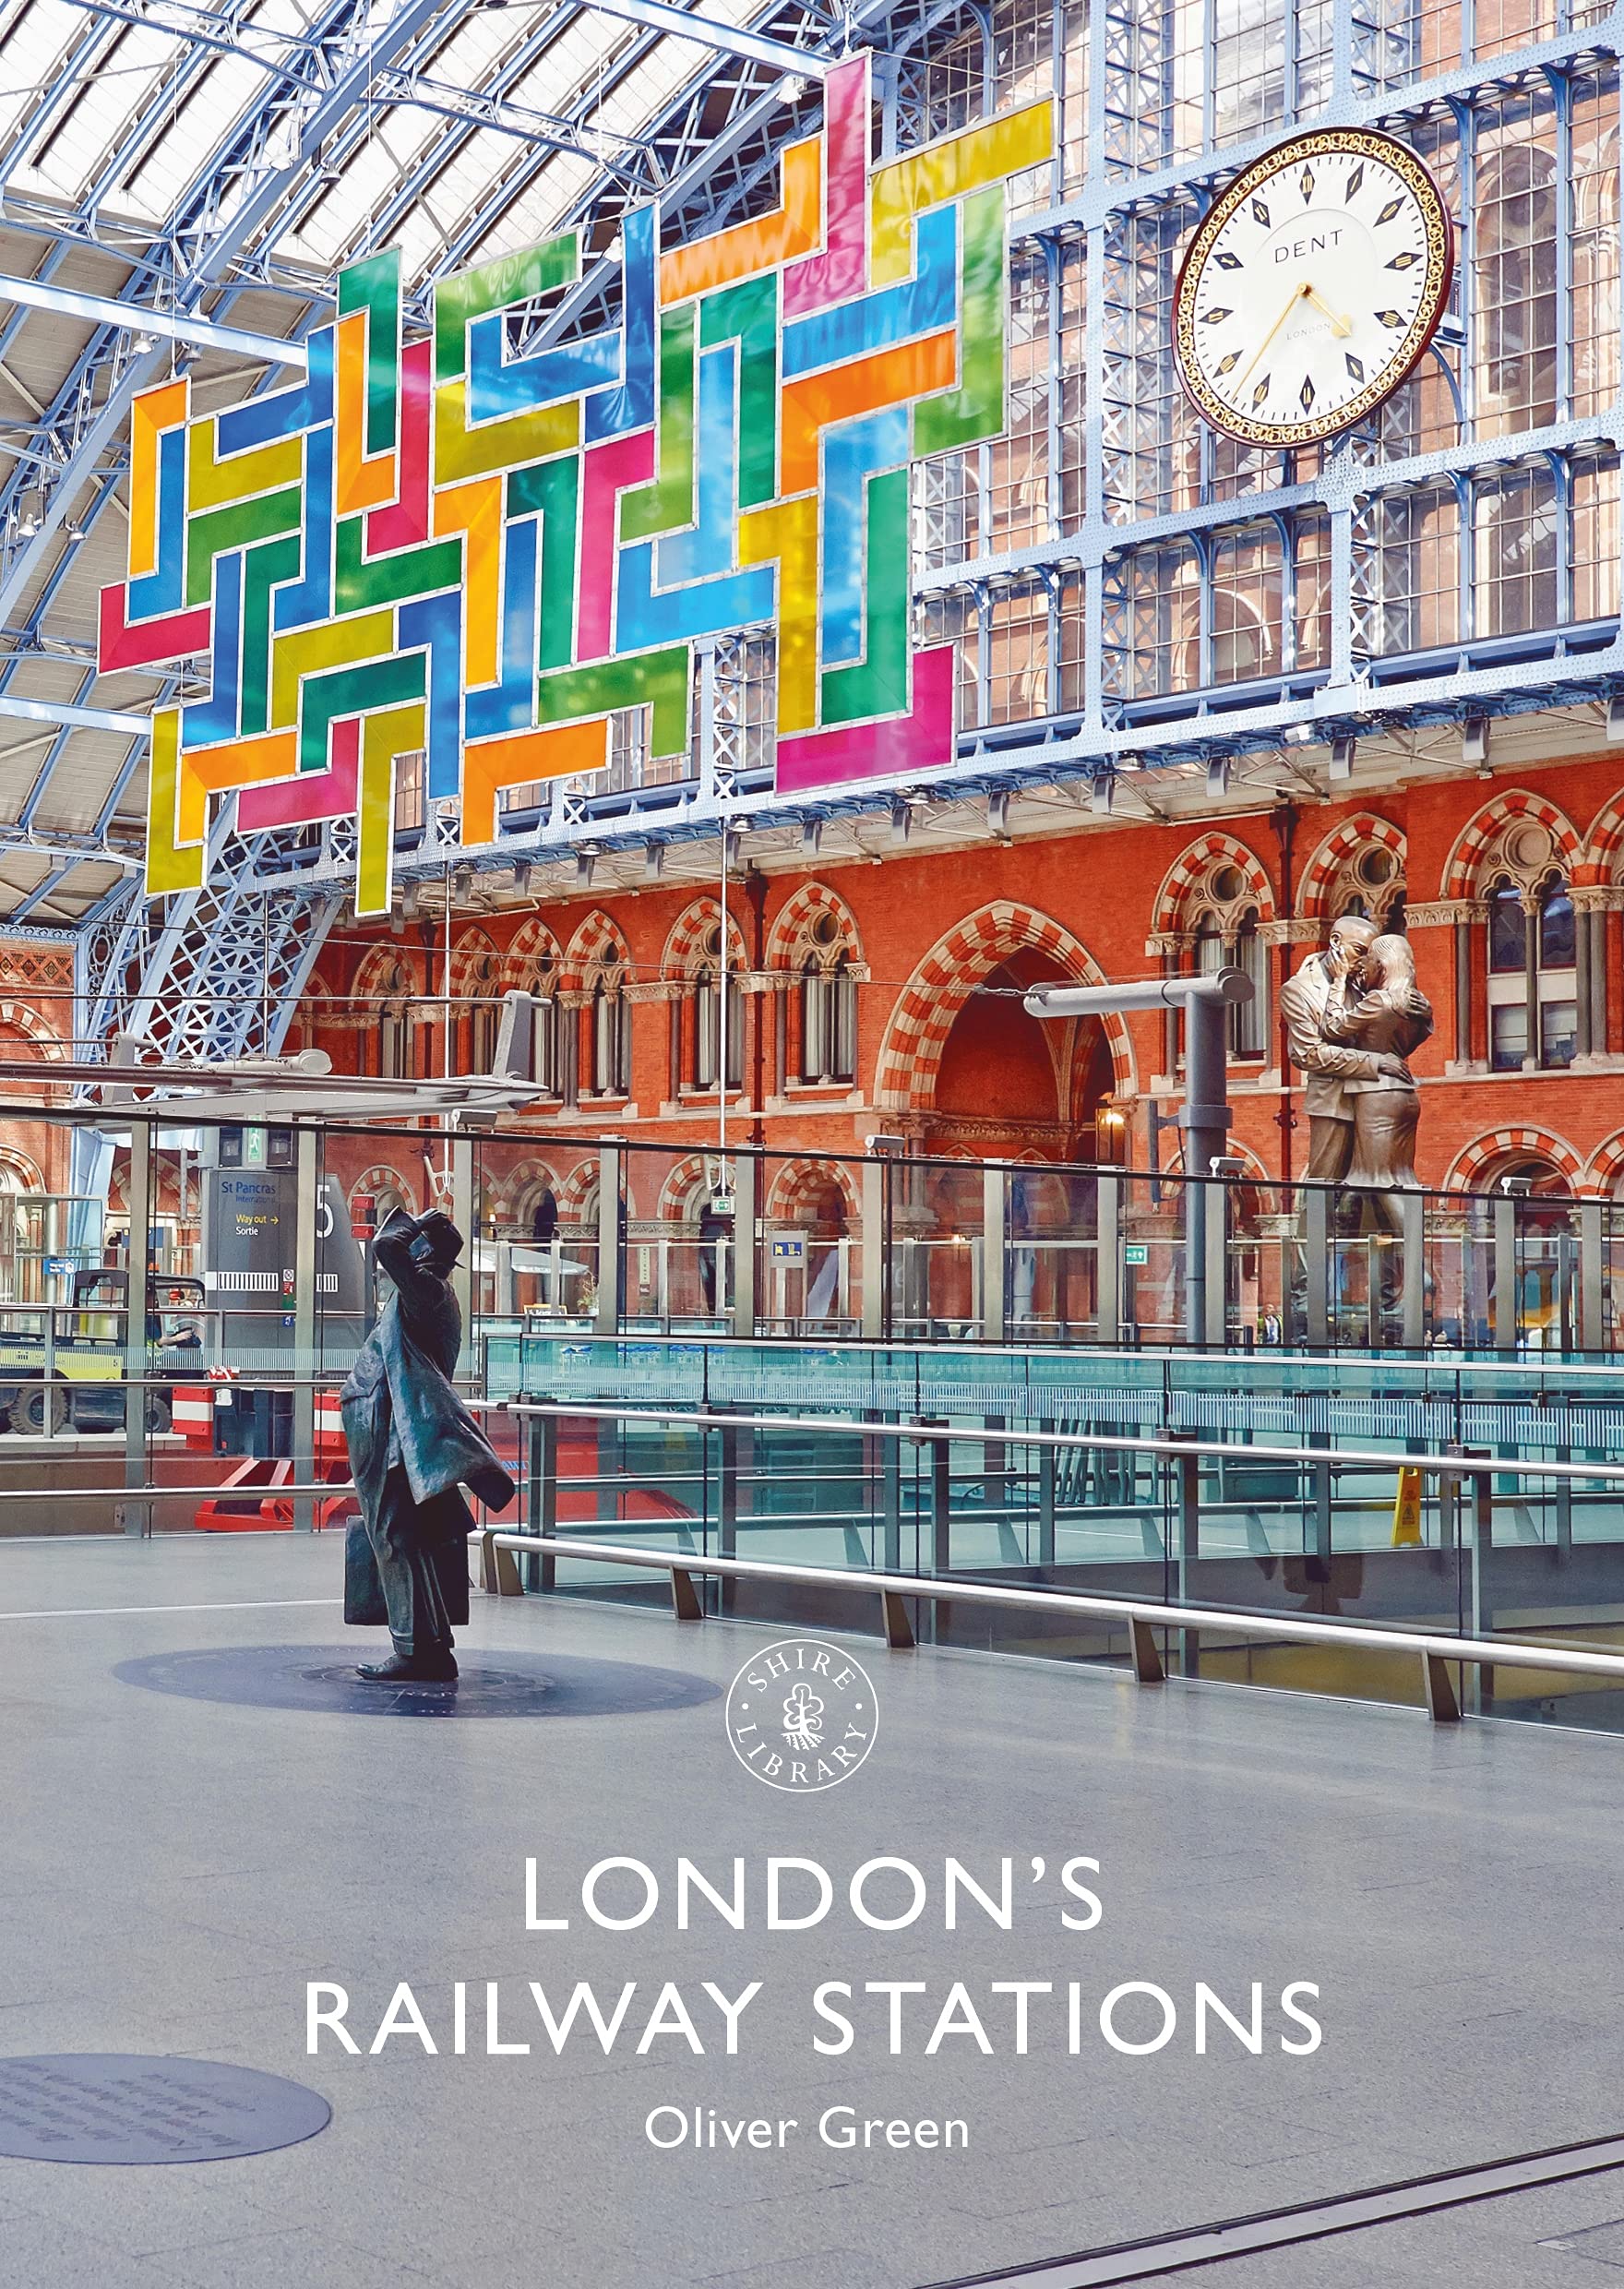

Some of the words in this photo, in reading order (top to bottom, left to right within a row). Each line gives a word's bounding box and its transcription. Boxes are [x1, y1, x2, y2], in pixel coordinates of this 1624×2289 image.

[1274, 229, 1343, 263] DENT
[1286, 323, 1331, 341] LONDON
[221, 1181, 233, 1194] St
[235, 1181, 276, 1194] Pancras
[316, 1184, 334, 1238] 5
[235, 1214, 254, 1226] Way
[254, 1215, 267, 1224] out
[235, 1226, 258, 1236] Sortie
